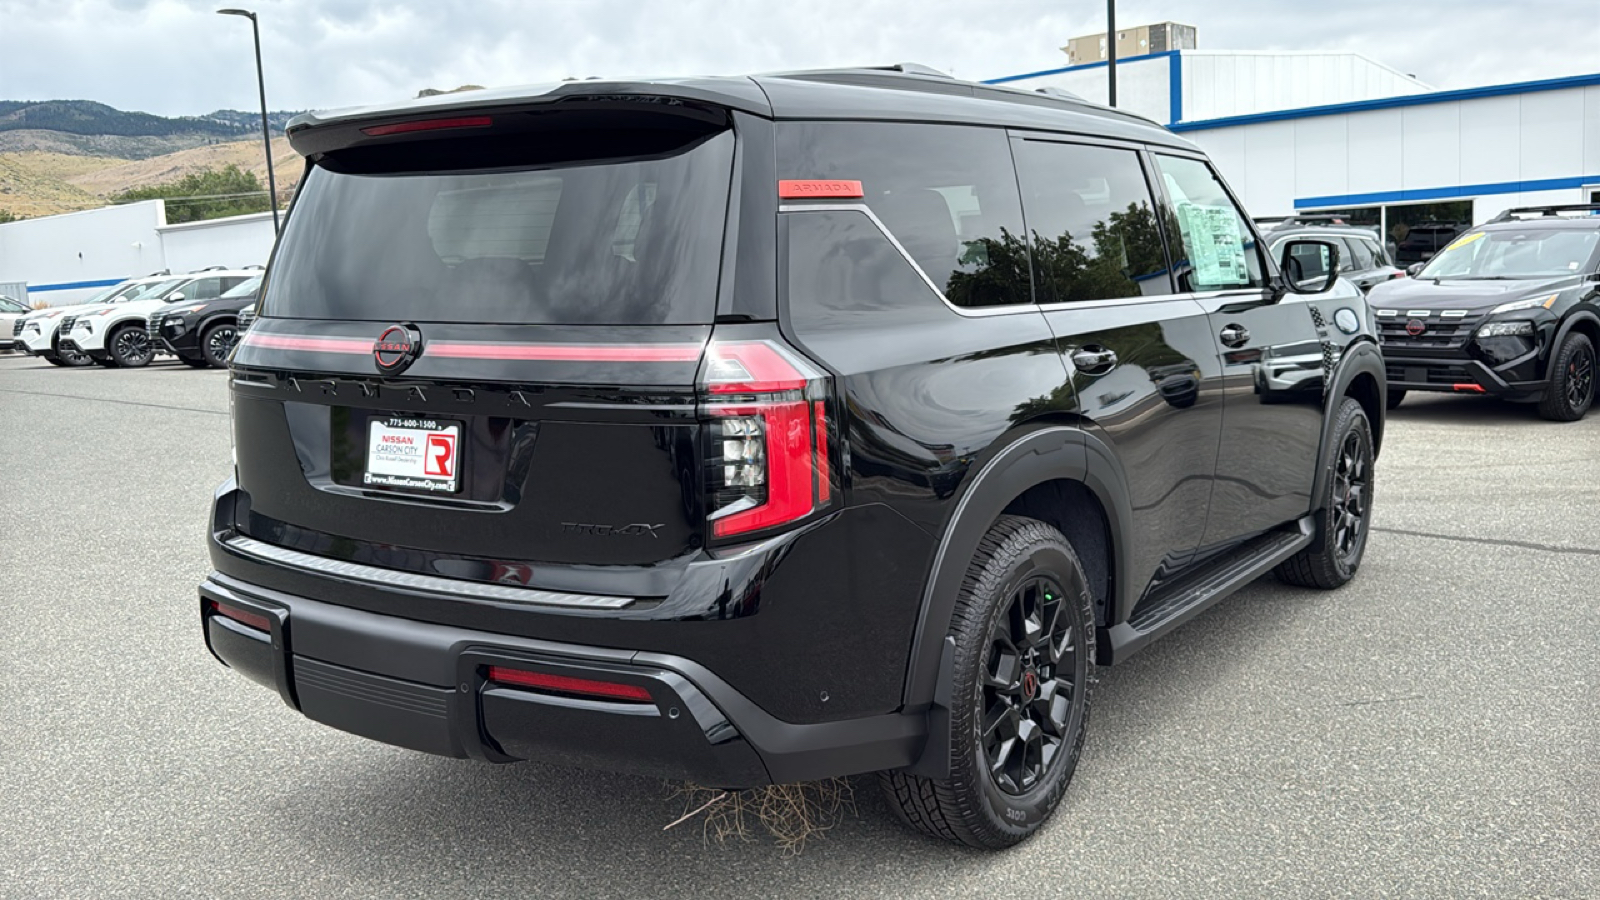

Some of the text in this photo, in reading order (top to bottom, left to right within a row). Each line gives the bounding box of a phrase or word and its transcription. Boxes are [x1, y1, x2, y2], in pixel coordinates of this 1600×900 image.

[793, 184, 852, 192] ARMADA
[284, 377, 531, 407] ARMADA
[382, 435, 414, 445] NISSAN
[376, 444, 418, 455] CARSON CITY
